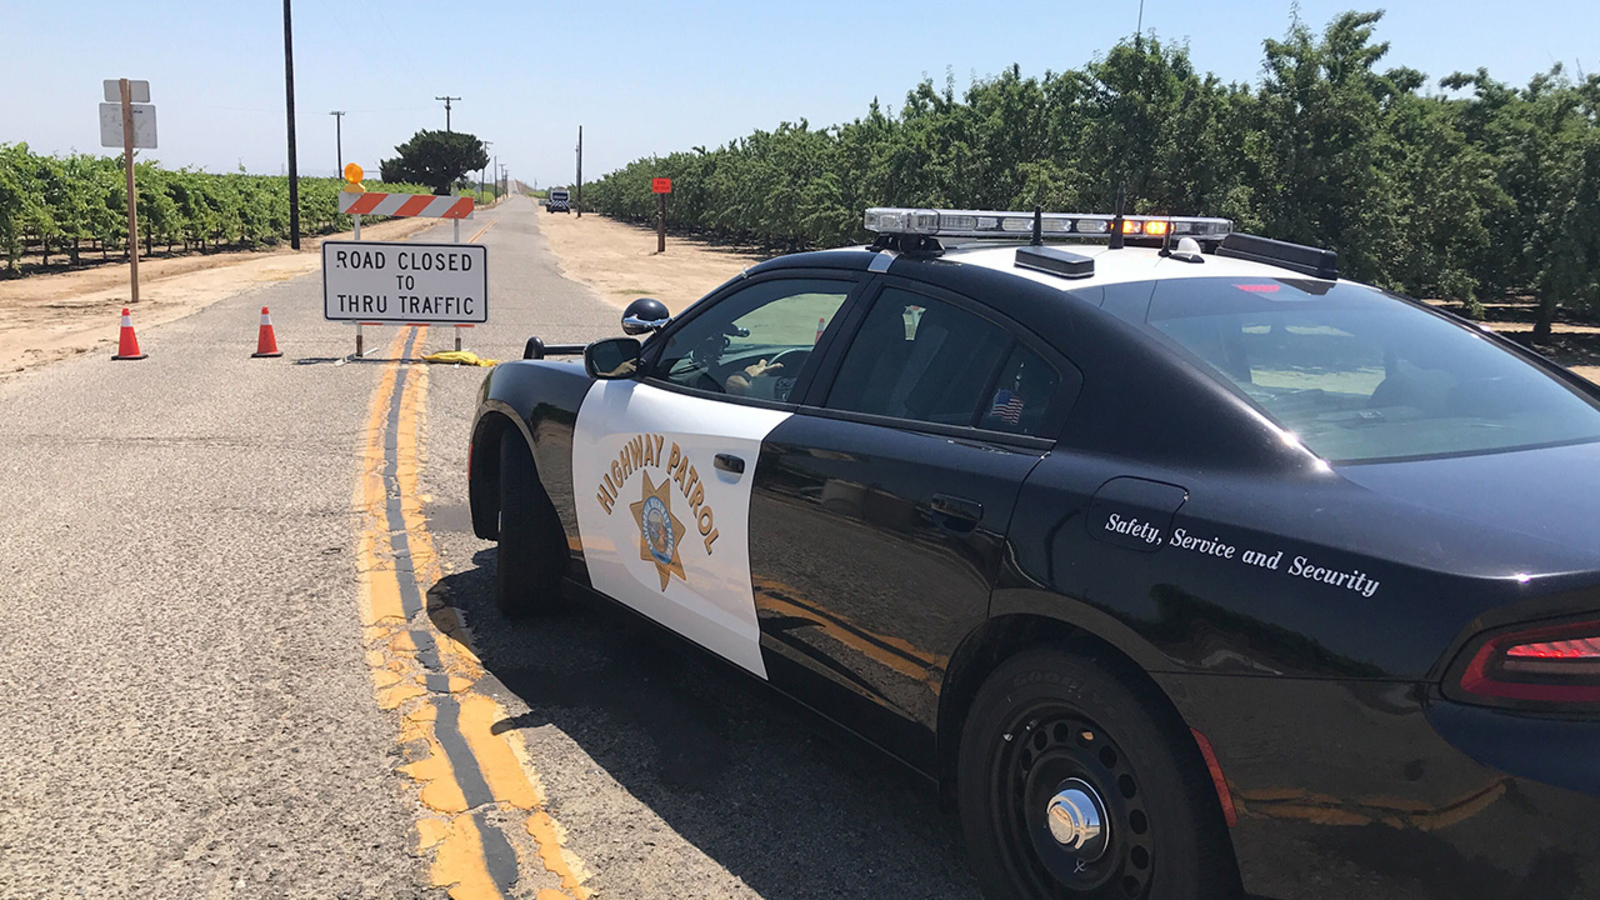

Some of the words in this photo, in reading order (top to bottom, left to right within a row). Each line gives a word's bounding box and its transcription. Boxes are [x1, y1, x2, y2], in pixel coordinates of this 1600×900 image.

[336, 251, 386, 269] ROAD
[398, 252, 472, 271] CLOSED
[396, 275, 415, 291] TO
[337, 294, 387, 313] THRU
[398, 296, 474, 315] TRAFFIC
[596, 433, 665, 516] HIGHWAY
[666, 441, 720, 556] PATROL
[1105, 513, 1162, 545] Safety,
[1169, 527, 1236, 559] Service
[1242, 550, 1284, 571] and
[1288, 555, 1380, 598] Security
